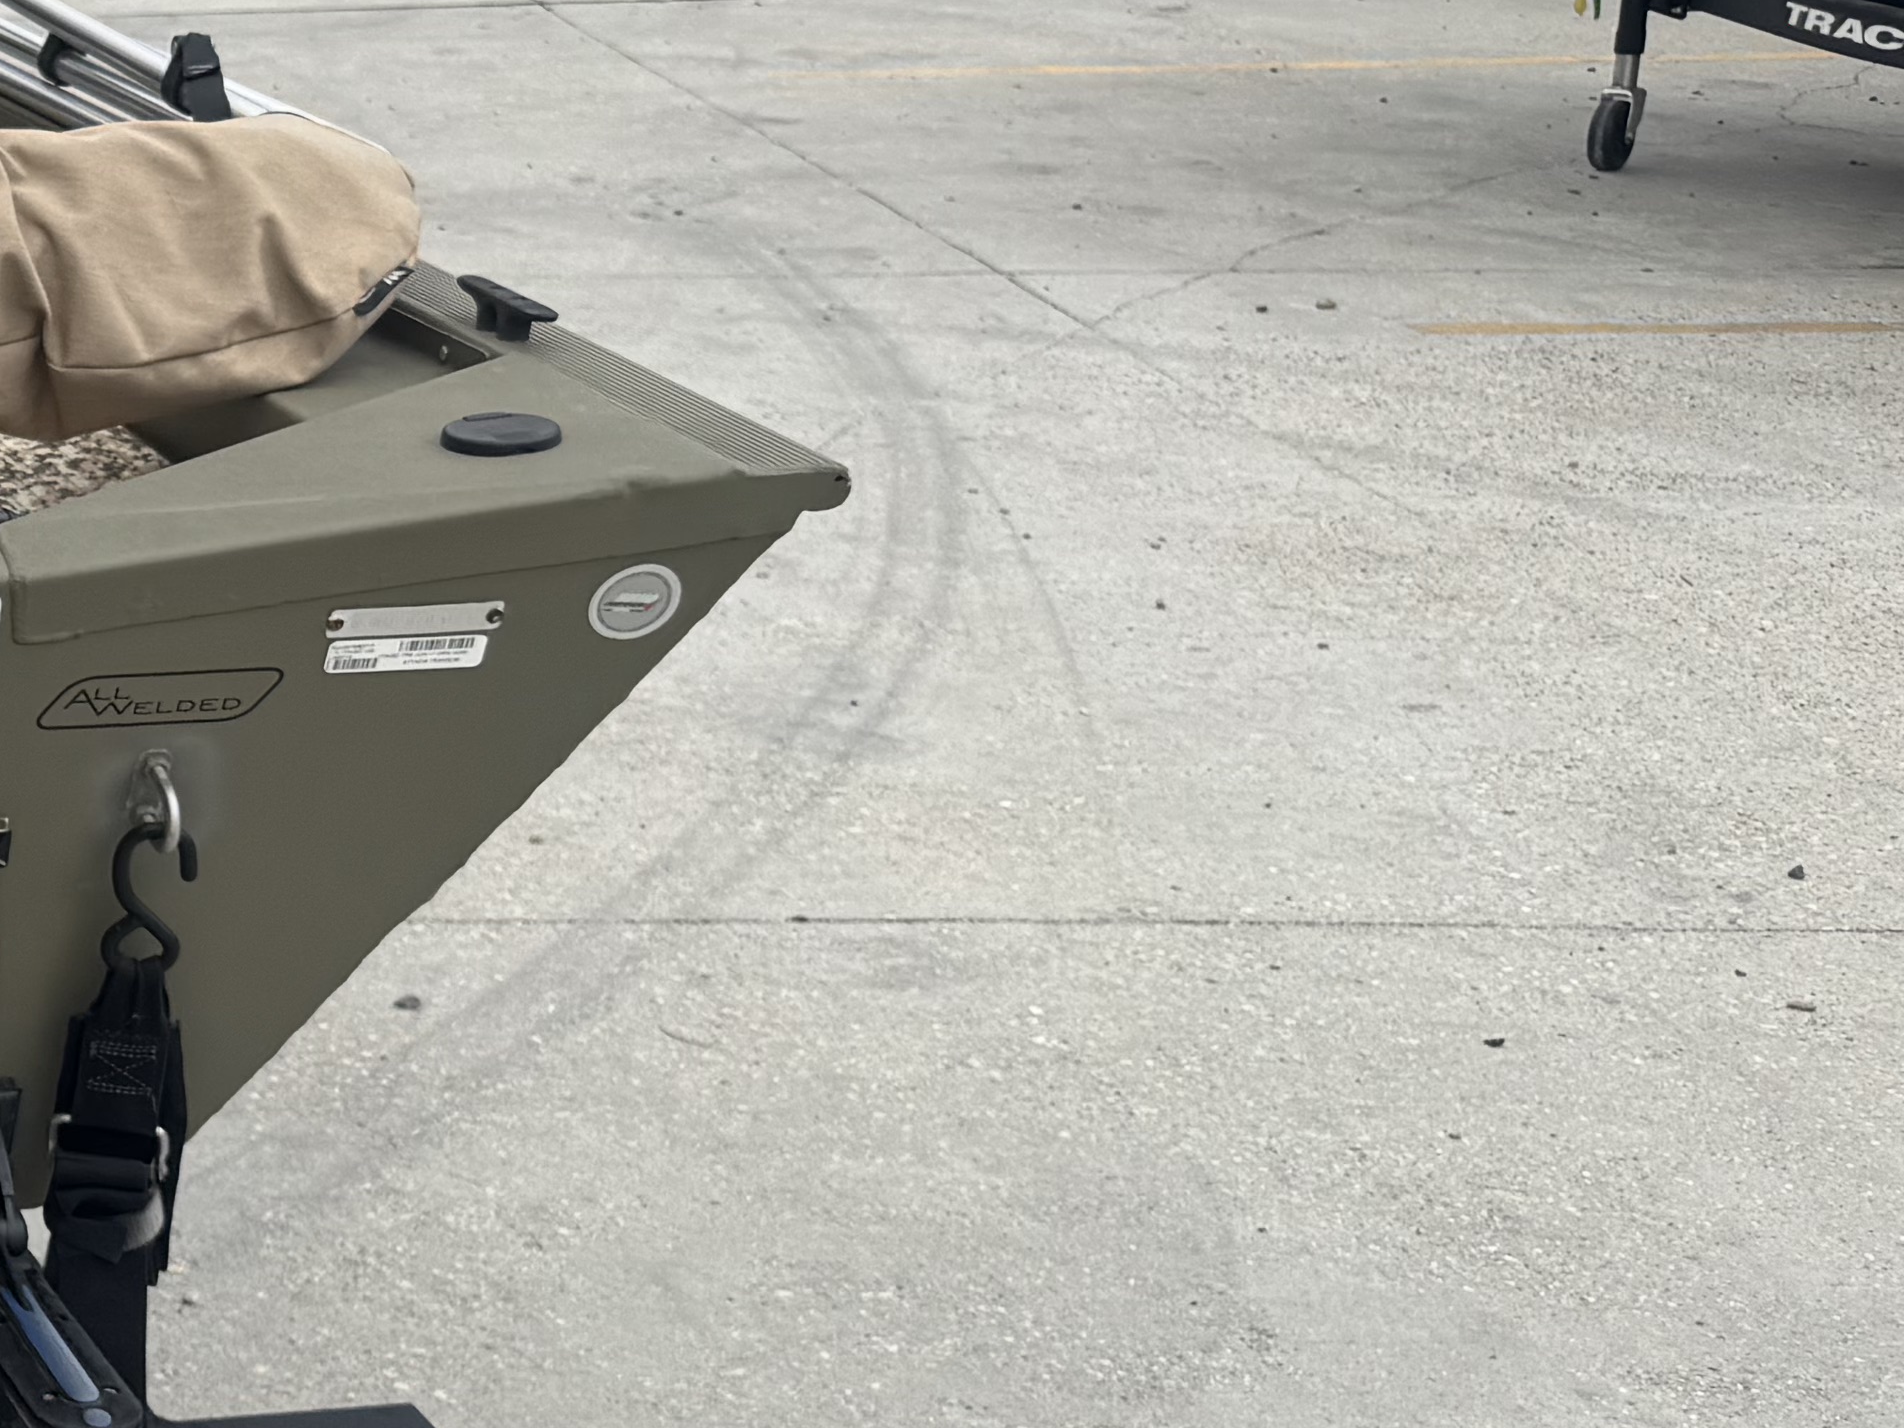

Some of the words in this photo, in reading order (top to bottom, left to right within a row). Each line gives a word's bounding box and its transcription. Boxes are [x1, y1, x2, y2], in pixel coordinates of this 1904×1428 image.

[1786, 1, 1904, 51] TRAC
[64, 687, 129, 711] ALL
[92, 697, 241, 717] WELDED
